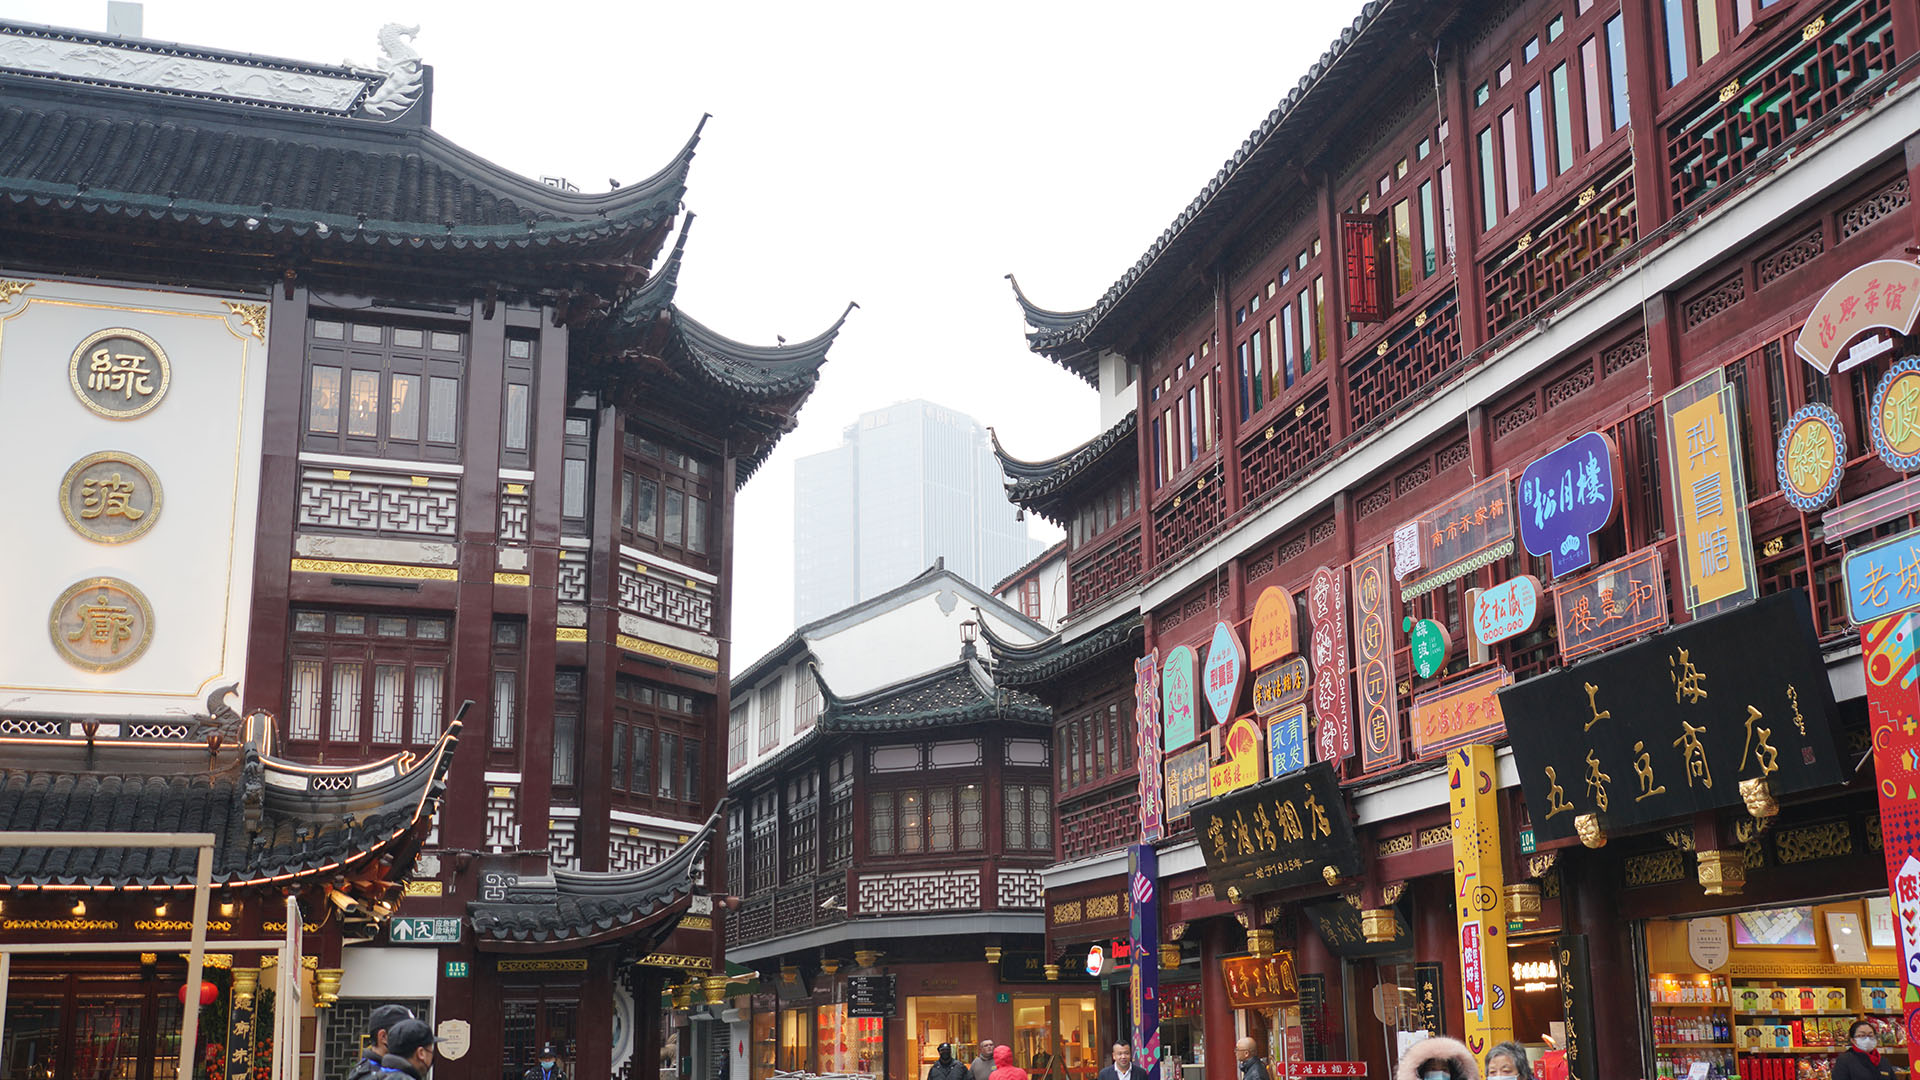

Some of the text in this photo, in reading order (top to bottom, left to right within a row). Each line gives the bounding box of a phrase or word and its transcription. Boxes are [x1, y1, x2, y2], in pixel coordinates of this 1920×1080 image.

[1685, 413, 1730, 578] 梨膏糖
[1363, 574, 1386, 744] 侬好元宵
[1583, 646, 1708, 732] 上海
[1544, 704, 1779, 821] 五香豆商店
[1521, 832, 1535, 846] 104
[448, 962, 466, 972] 115
